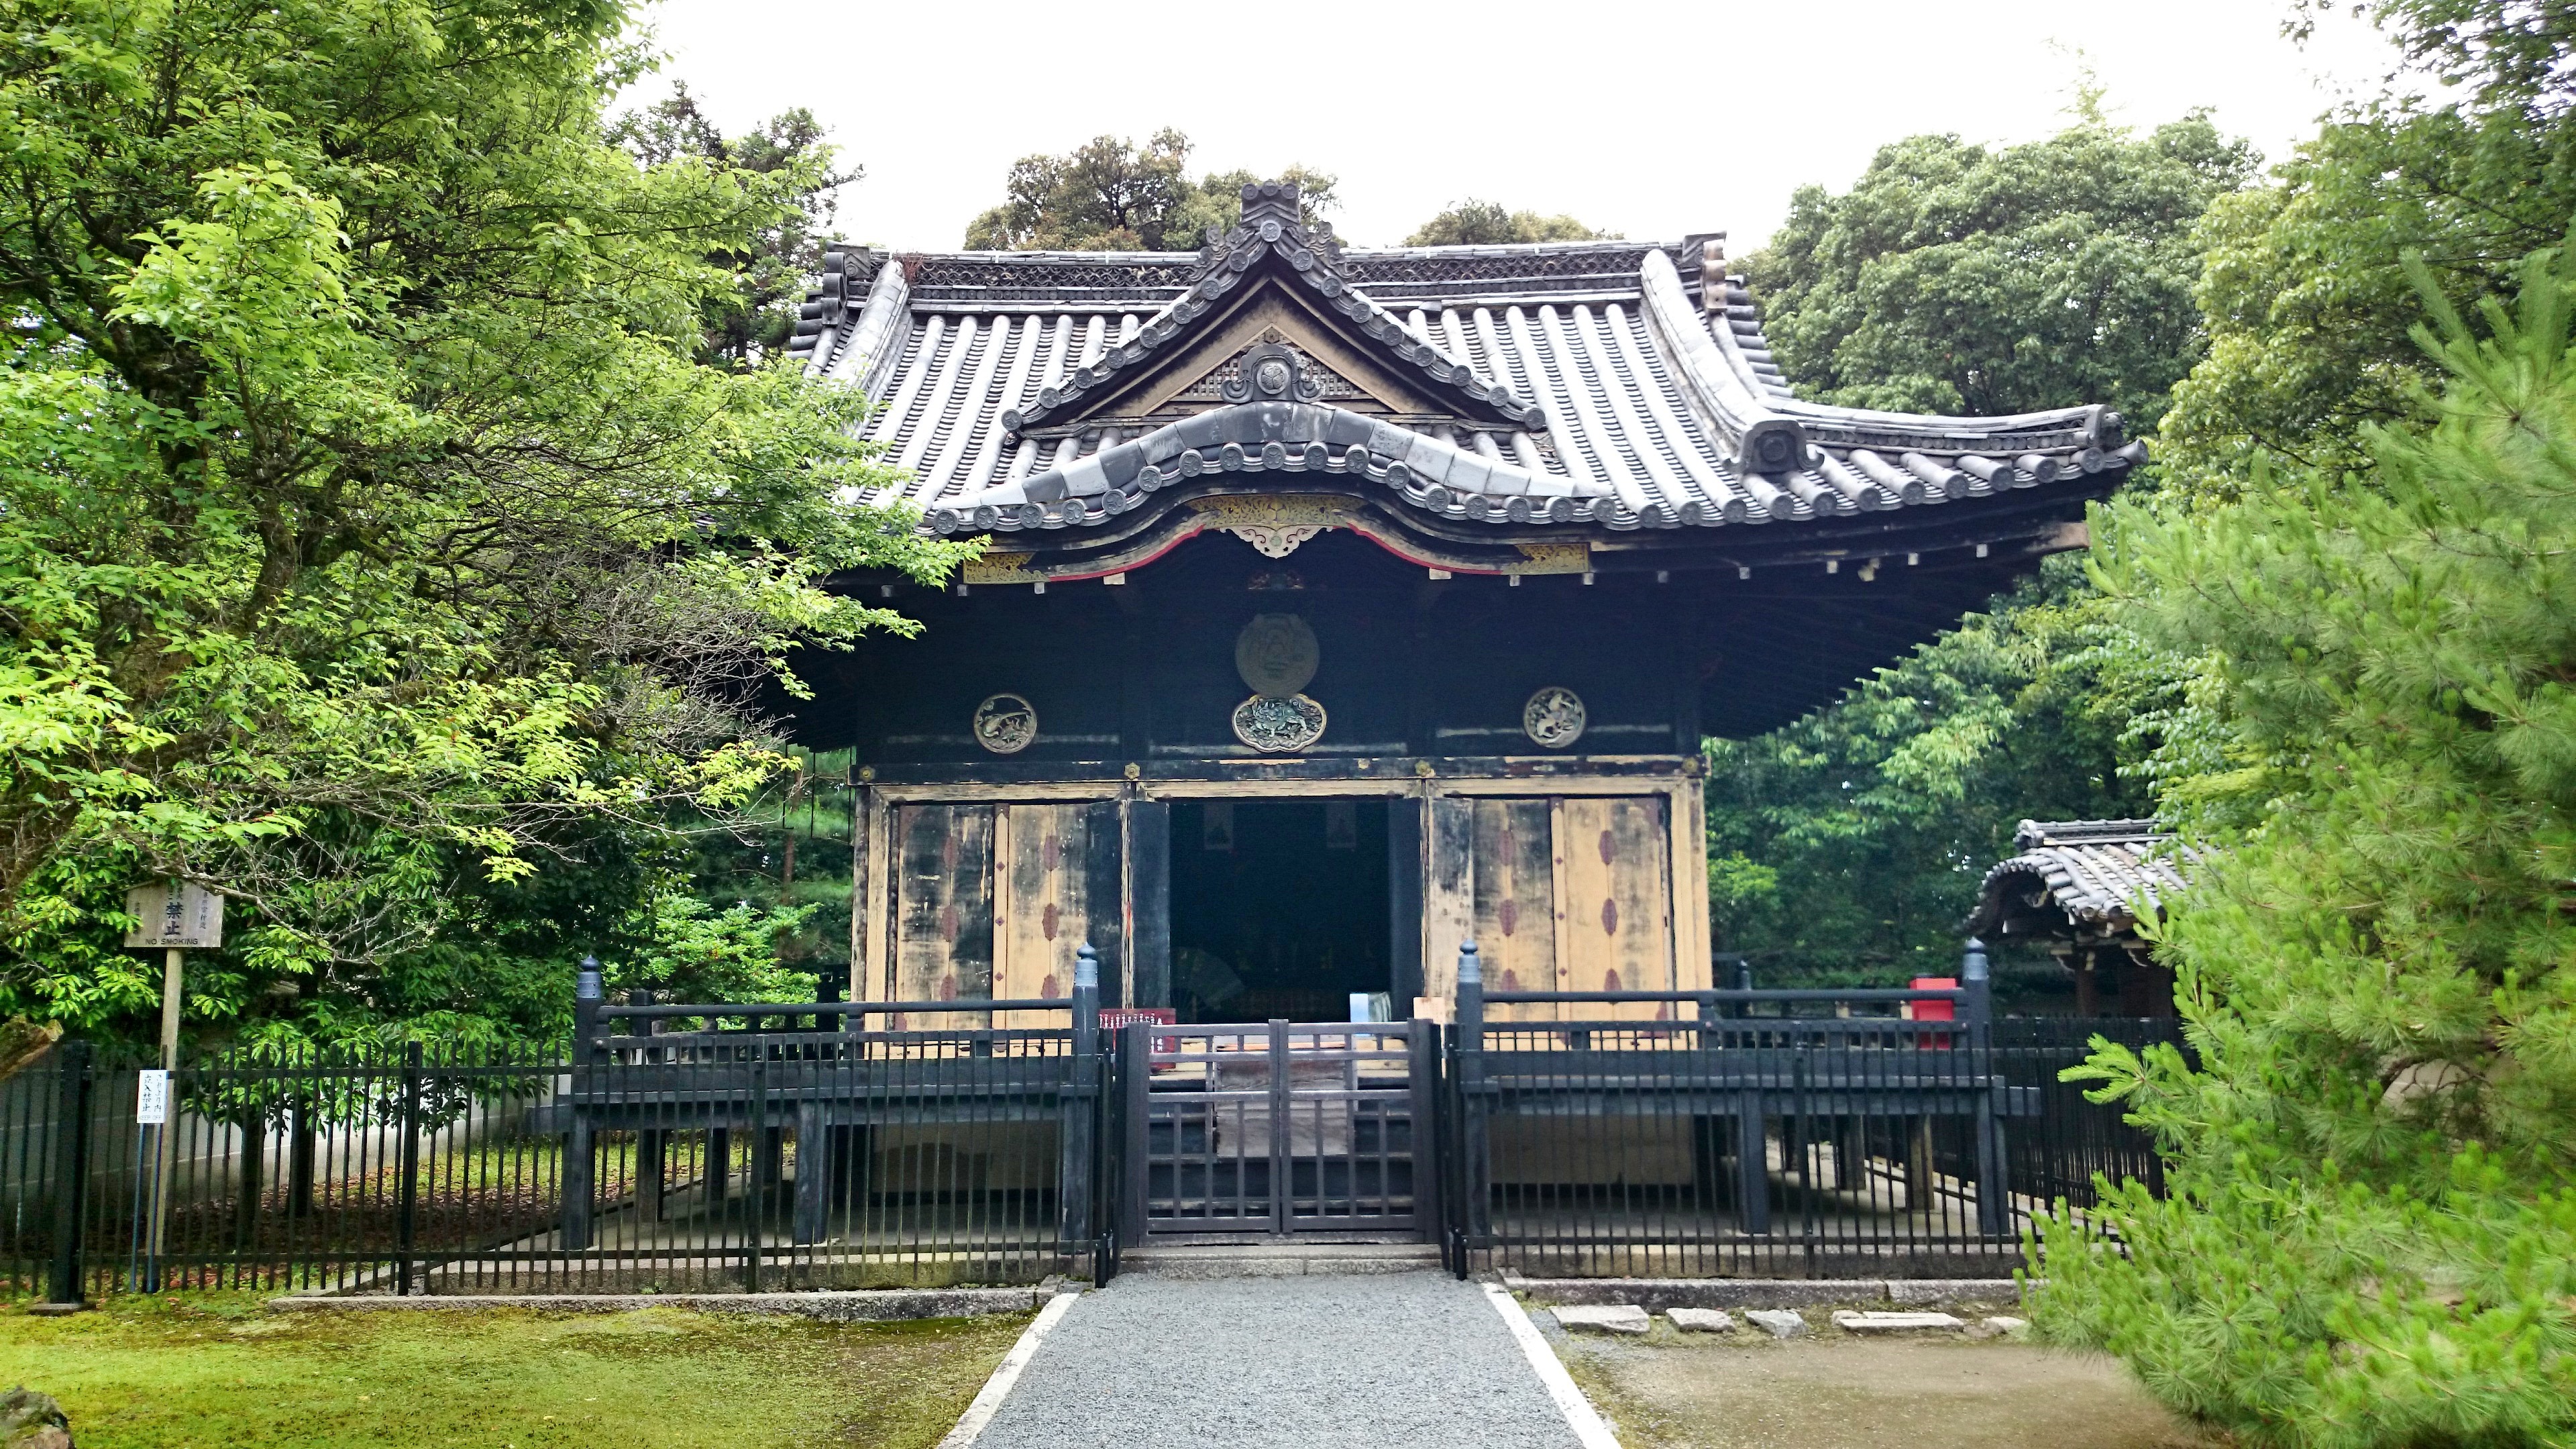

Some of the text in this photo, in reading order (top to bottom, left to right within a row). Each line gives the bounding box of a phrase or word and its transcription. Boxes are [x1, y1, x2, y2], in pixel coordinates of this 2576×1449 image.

[142, 1074, 152, 1112] 立入禁止
[154, 1074, 162, 1112] これより内
